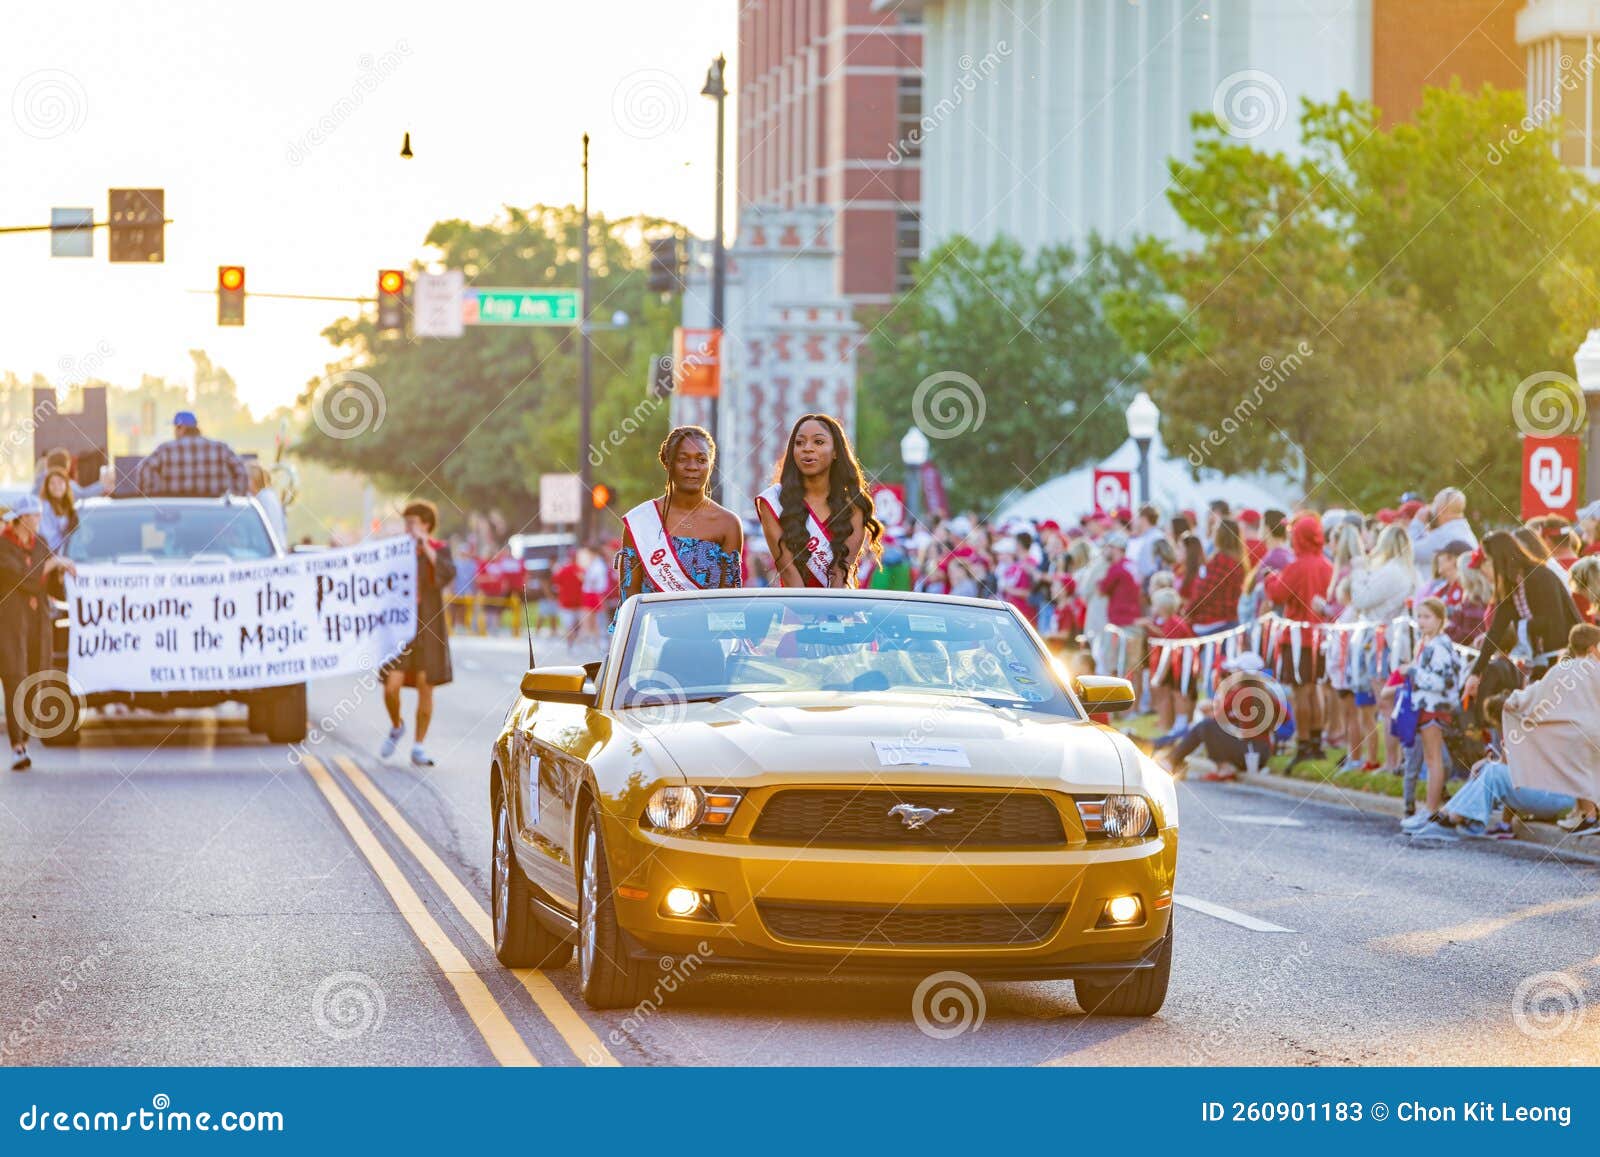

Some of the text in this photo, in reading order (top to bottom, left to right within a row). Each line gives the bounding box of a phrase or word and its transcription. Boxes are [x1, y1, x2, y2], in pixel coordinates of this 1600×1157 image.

[1530, 446, 1573, 508] OU
[95, 574, 150, 588] UNIVERSITY
[153, 574, 166, 588] OF
[171, 572, 225, 588] OKLAHOMA
[353, 549, 380, 565] WEEK
[76, 571, 410, 627] Welcome to the Palace:
[78, 607, 410, 658] Where all the Magic Happens
[151, 667, 176, 682] BETA
[190, 666, 224, 682] THETA
[227, 664, 262, 680] HARRY
[267, 660, 305, 676] POTTER
